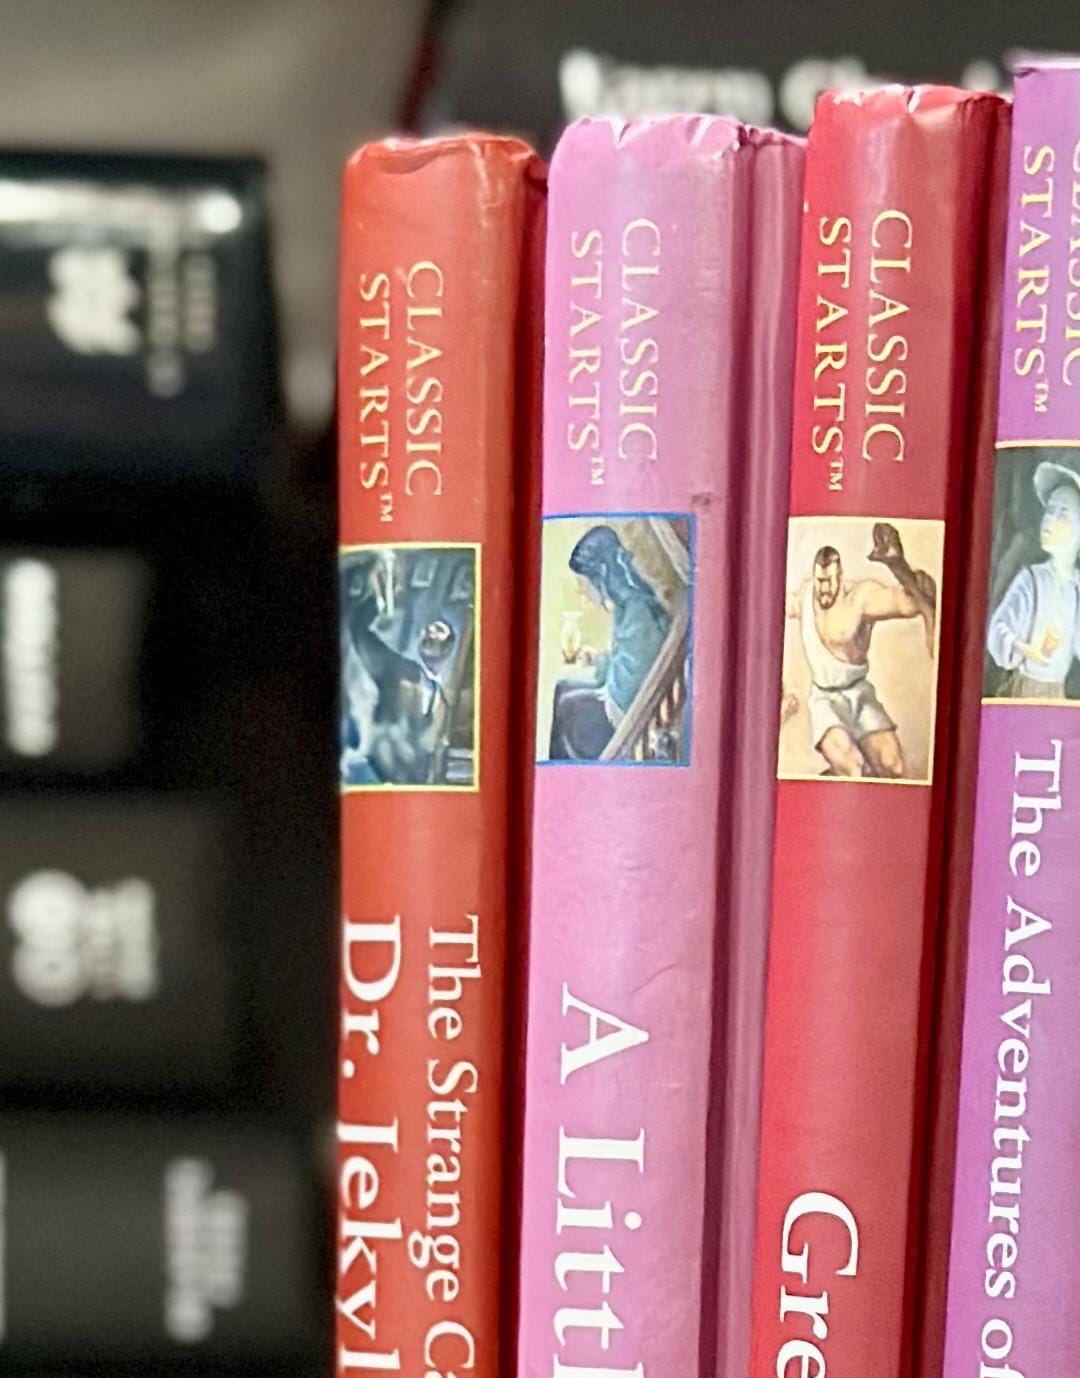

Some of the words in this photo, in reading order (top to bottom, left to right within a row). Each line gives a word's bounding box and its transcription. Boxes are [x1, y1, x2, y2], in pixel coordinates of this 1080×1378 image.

[405, 260, 444, 498] CLASSIC
[620, 218, 661, 461] CLASSIC
[863, 209, 913, 462] CLASSIC
[1008, 740, 1064, 878] The
[339, 914, 400, 1080] Dr.
[425, 914, 481, 1040] The
[558, 982, 650, 1085] A
[407, 1059, 477, 1303] Strange
[984, 898, 1054, 1301] Adventures
